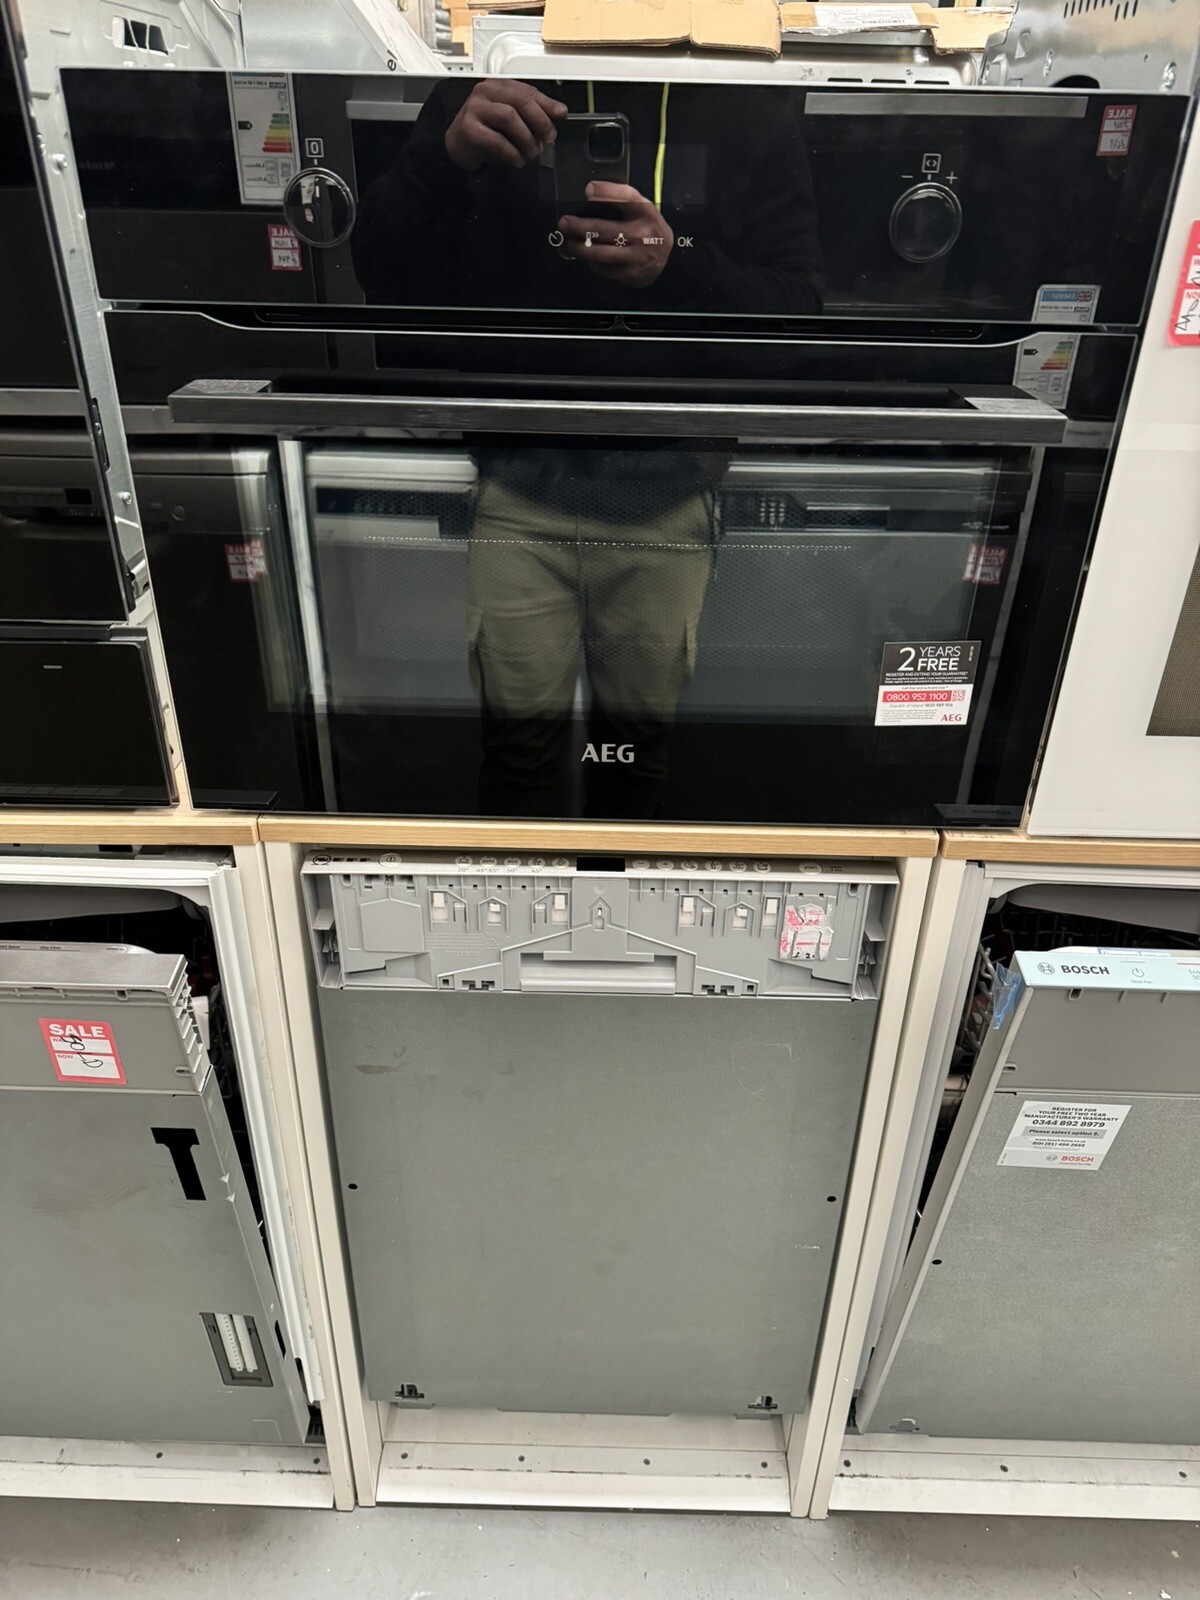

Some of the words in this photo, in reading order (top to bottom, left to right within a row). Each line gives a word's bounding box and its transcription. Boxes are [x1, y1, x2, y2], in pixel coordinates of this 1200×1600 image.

[643, 237, 664, 245] WATT
[678, 236, 694, 248] OK
[898, 647, 916, 671] 2
[920, 646, 961, 658] YEARS
[917, 658, 960, 670] FREE
[940, 714, 962, 722] AEG
[580, 743, 635, 763] AEG
[1060, 965, 1110, 975] BOSCH
[49, 1024, 106, 1038] SALE
